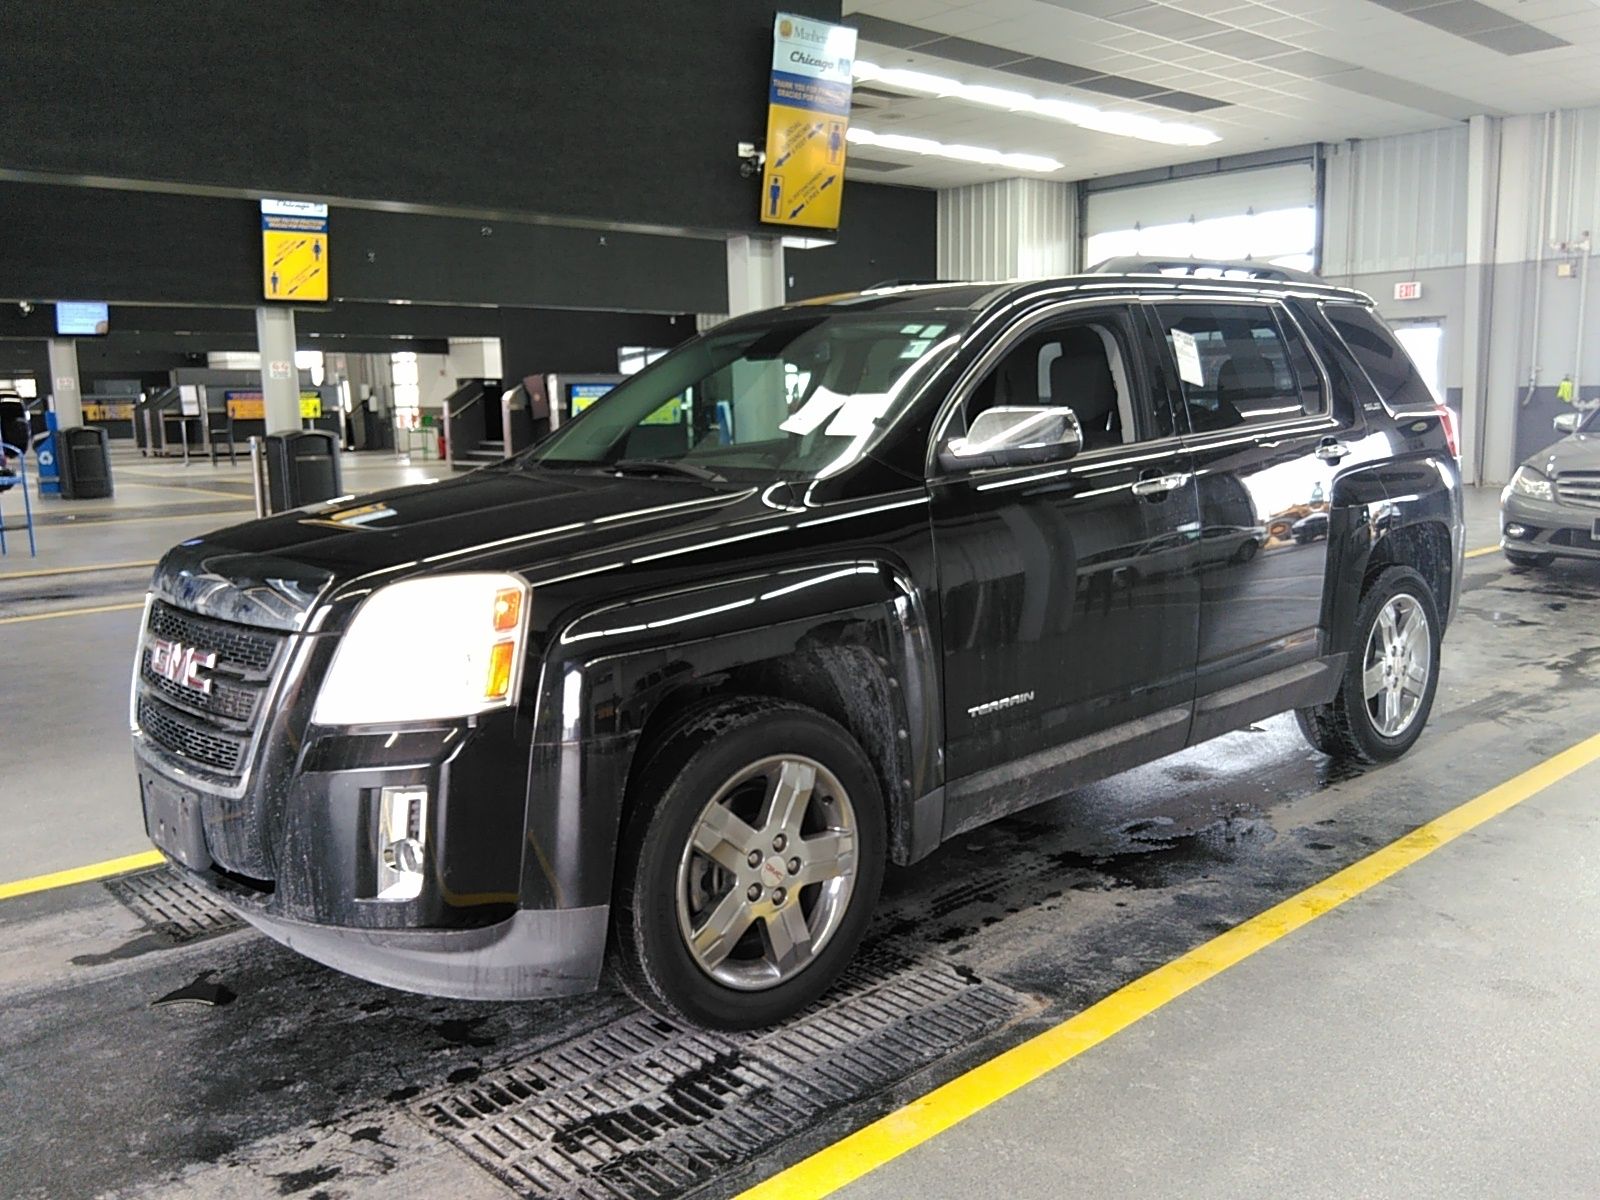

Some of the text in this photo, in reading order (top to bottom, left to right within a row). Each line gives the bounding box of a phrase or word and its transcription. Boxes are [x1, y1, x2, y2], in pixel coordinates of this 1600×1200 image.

[789, 50, 834, 72] Chicago
[1400, 283, 1416, 298] EXIT
[152, 639, 216, 694] GMC
[967, 690, 1035, 718] TERRAIN
